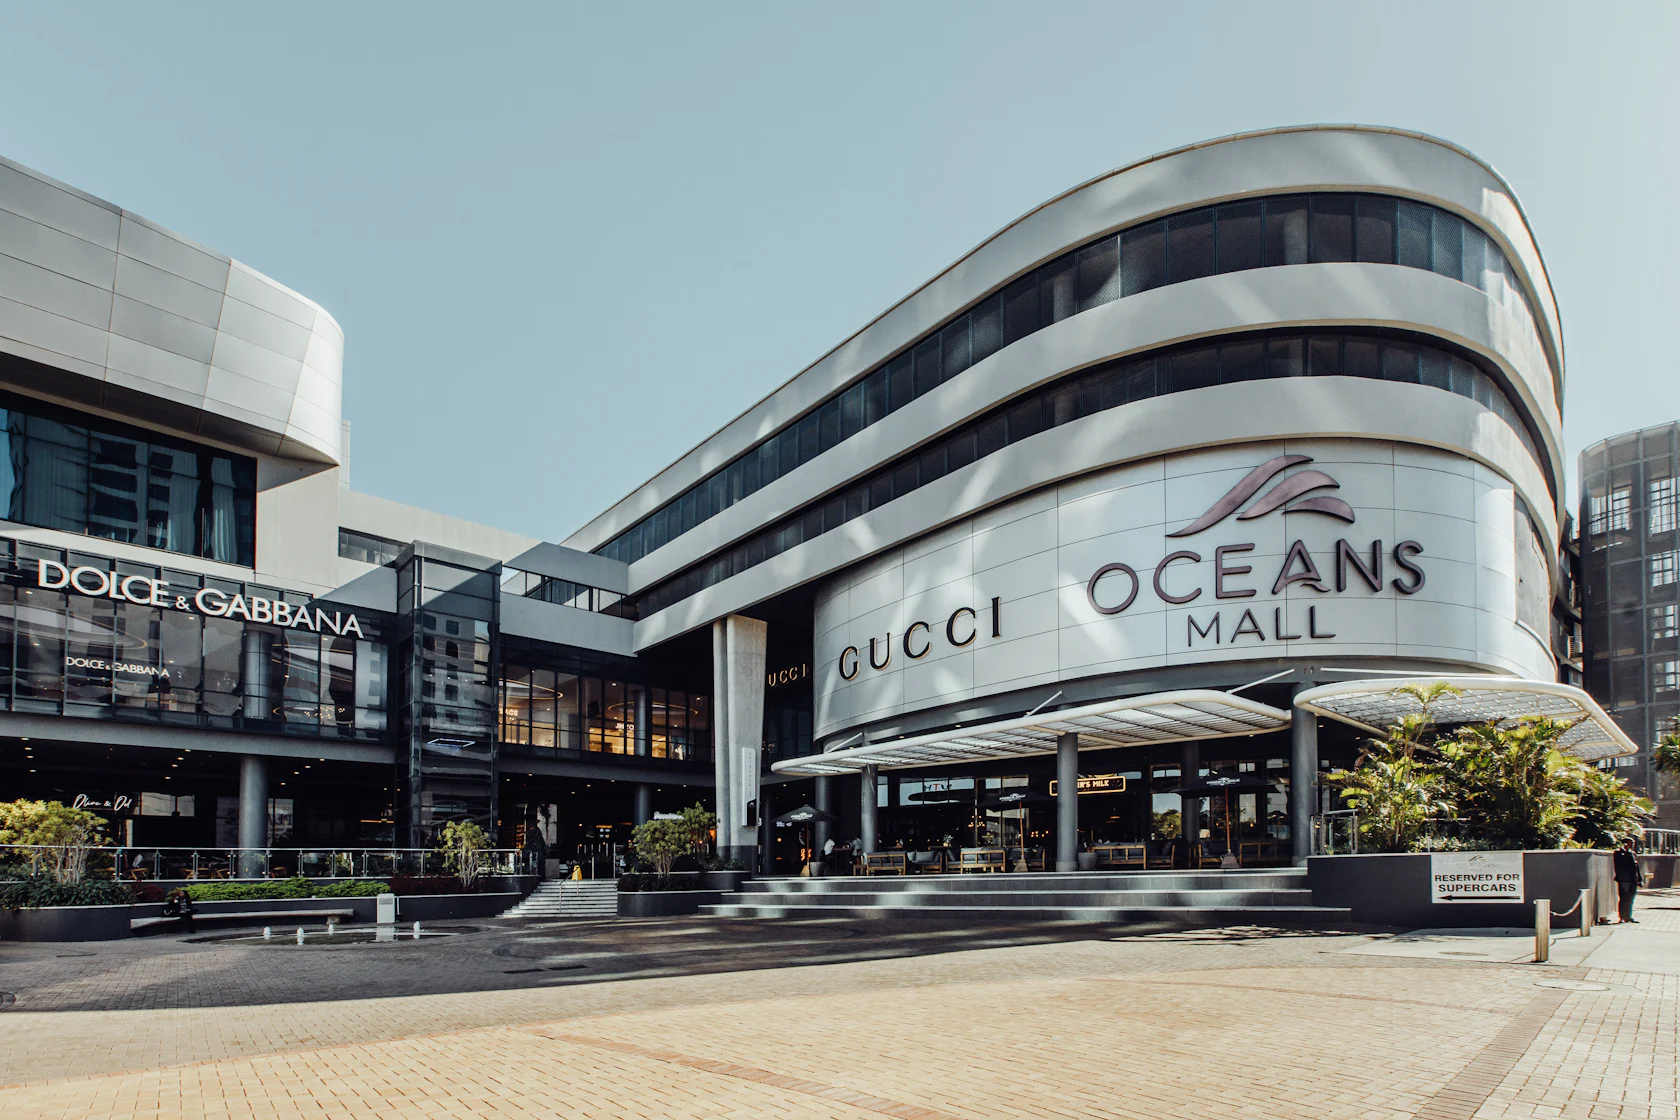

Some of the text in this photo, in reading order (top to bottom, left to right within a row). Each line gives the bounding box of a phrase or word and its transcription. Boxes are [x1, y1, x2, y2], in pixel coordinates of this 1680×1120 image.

[1087, 538, 1425, 615] OCEANS
[38, 558, 365, 638] DOLCE & GABBANA
[1187, 604, 1336, 647] MALL
[839, 596, 1001, 681] GUCCI
[66, 656, 104, 670] DOLCE
[112, 662, 170, 678] GABBANA
[768, 663, 806, 687] UCCI
[1092, 780, 1109, 788] MILK
[1434, 873, 1520, 882] RESERVED FOR
[1438, 884, 1516, 892] SUPERCARS
